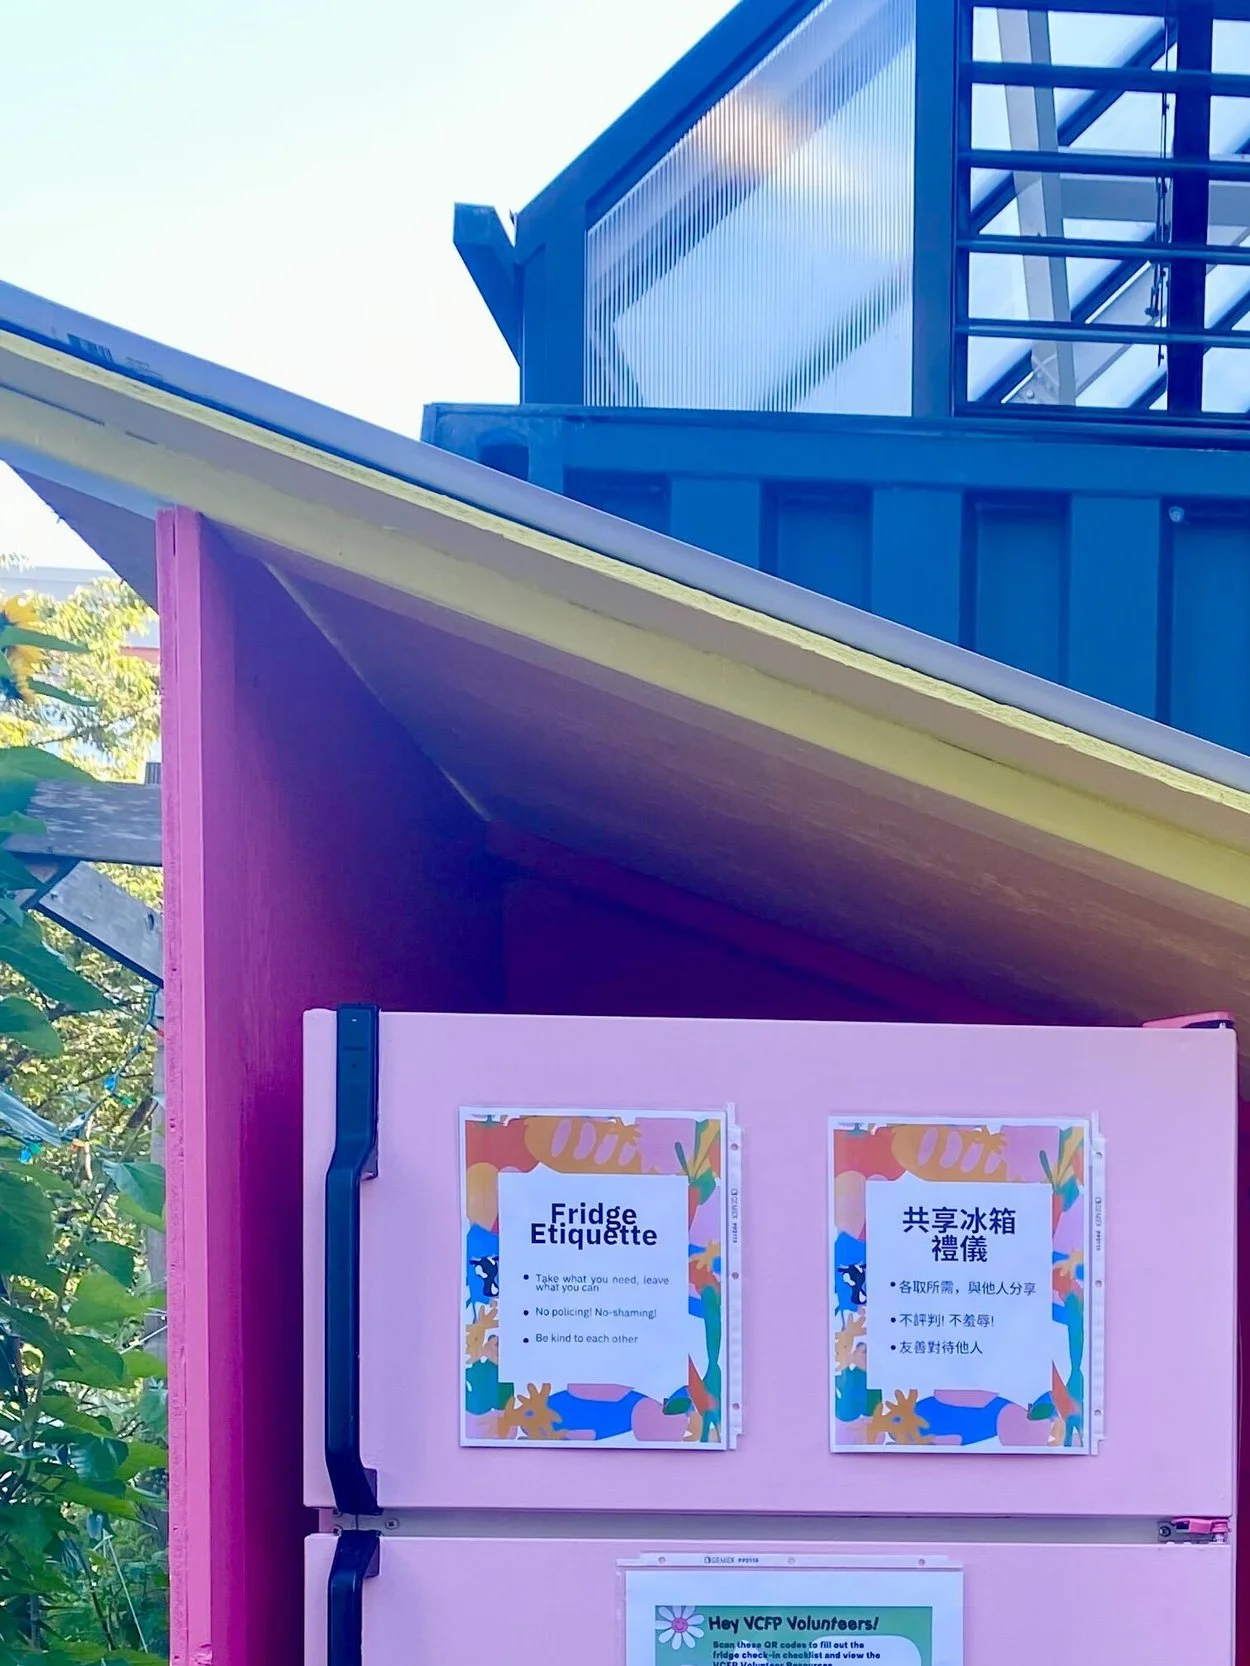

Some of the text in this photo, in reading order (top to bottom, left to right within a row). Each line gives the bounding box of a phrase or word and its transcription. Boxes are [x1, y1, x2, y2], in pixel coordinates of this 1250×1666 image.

[551, 1203, 637, 1231] Fridge
[902, 1206, 1016, 1234] 共享冰箱
[531, 1224, 658, 1249] Etiquette
[932, 1235, 987, 1262] 禮儀
[536, 1274, 669, 1287] Take what you need, leave
[536, 1283, 560, 1292] what
[562, 1285, 579, 1294] you
[536, 1307, 549, 1316] No
[552, 1307, 593, 1319] policing!
[536, 1334, 638, 1344] Be kind to each other
[900, 1341, 983, 1354] 友善對待他人
[708, 1615, 879, 1634] Hey VCFP Volunteers!
[713, 1641, 864, 1649] Scan these QR codes to fill out the
[713, 1651, 880, 1661] fridge check-in checklist and view the
